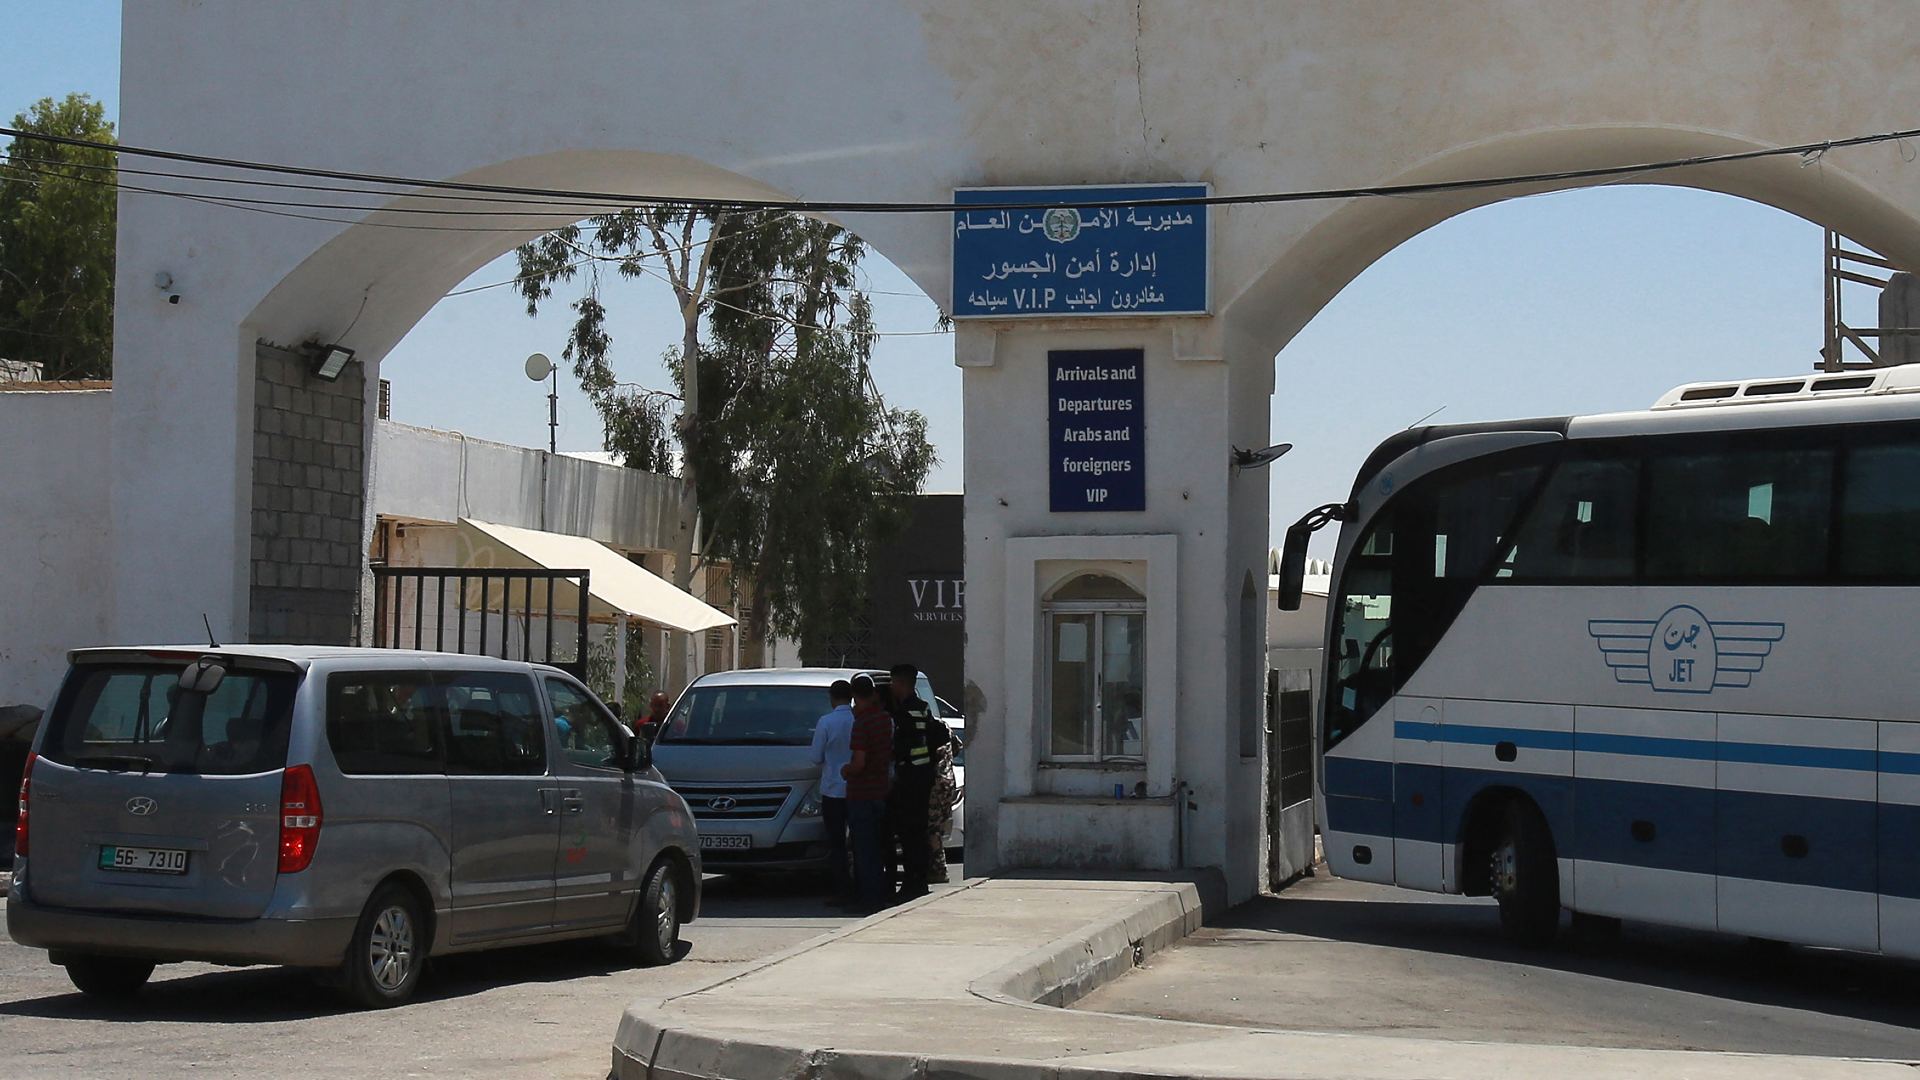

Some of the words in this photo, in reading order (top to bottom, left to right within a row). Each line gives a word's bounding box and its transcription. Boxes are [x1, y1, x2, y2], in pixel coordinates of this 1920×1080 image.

[956, 210, 1010, 239] العام
[1127, 206, 1192, 231] مديرية
[982, 252, 1056, 280] الجسور
[1065, 247, 1100, 278] أمن
[1110, 251, 1156, 277] إدارة
[968, 289, 1007, 311] سياحه
[1013, 288, 1056, 309] V.I.P
[1065, 288, 1100, 309] اجانب
[1111, 285, 1164, 309] مغادرون
[1056, 366, 1109, 381] Arrivals
[1110, 365, 1136, 380] and
[1058, 398, 1132, 414] Departures
[1064, 428, 1102, 442] Arabs
[1104, 427, 1130, 441] and
[1063, 457, 1131, 476] foreigners
[1086, 488, 1108, 502] VIP
[913, 612, 963, 621] SERVICES
[1664, 623, 1700, 651] جت
[1669, 659, 1695, 682] JET
[699, 836, 748, 848] 70-39324
[148, 851, 184, 869] 7310
